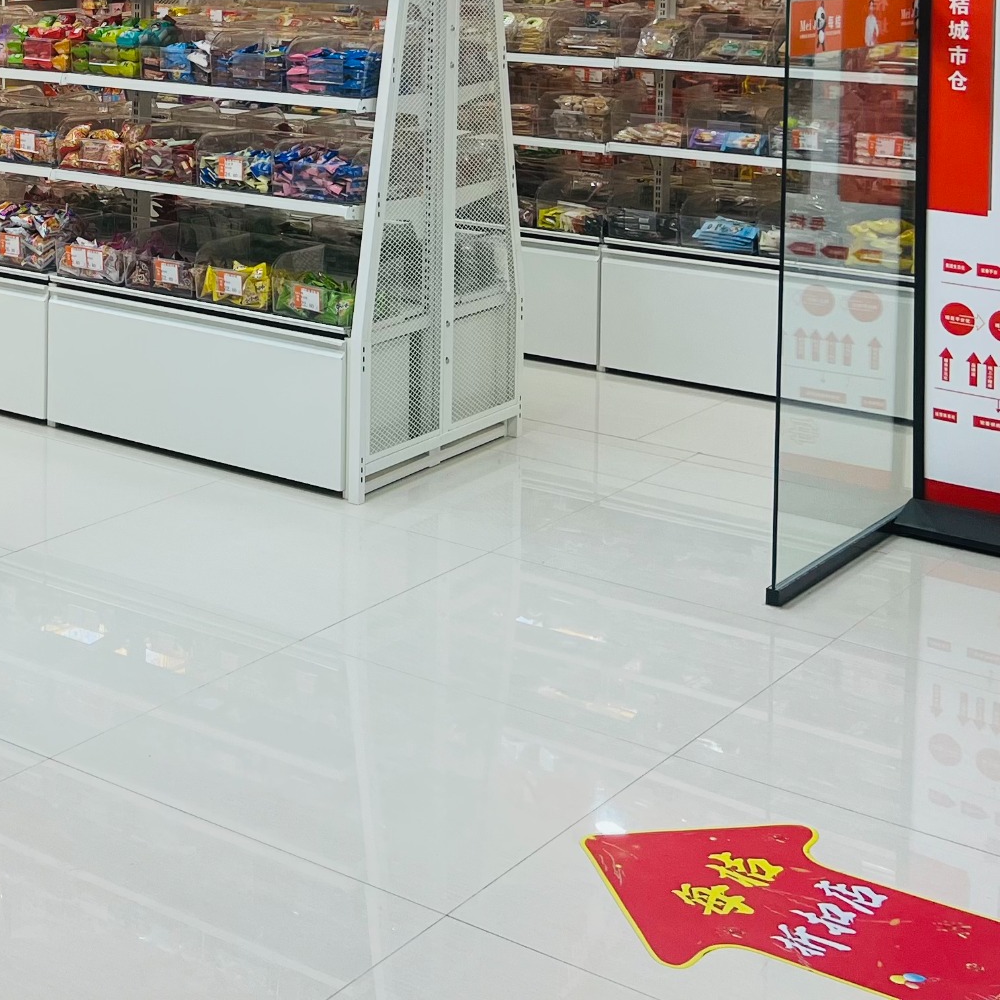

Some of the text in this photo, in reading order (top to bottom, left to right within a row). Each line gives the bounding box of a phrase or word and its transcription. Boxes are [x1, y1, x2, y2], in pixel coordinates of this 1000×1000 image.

[671, 851, 784, 915] 每桔
[770, 880, 888, 957] 折扣店
